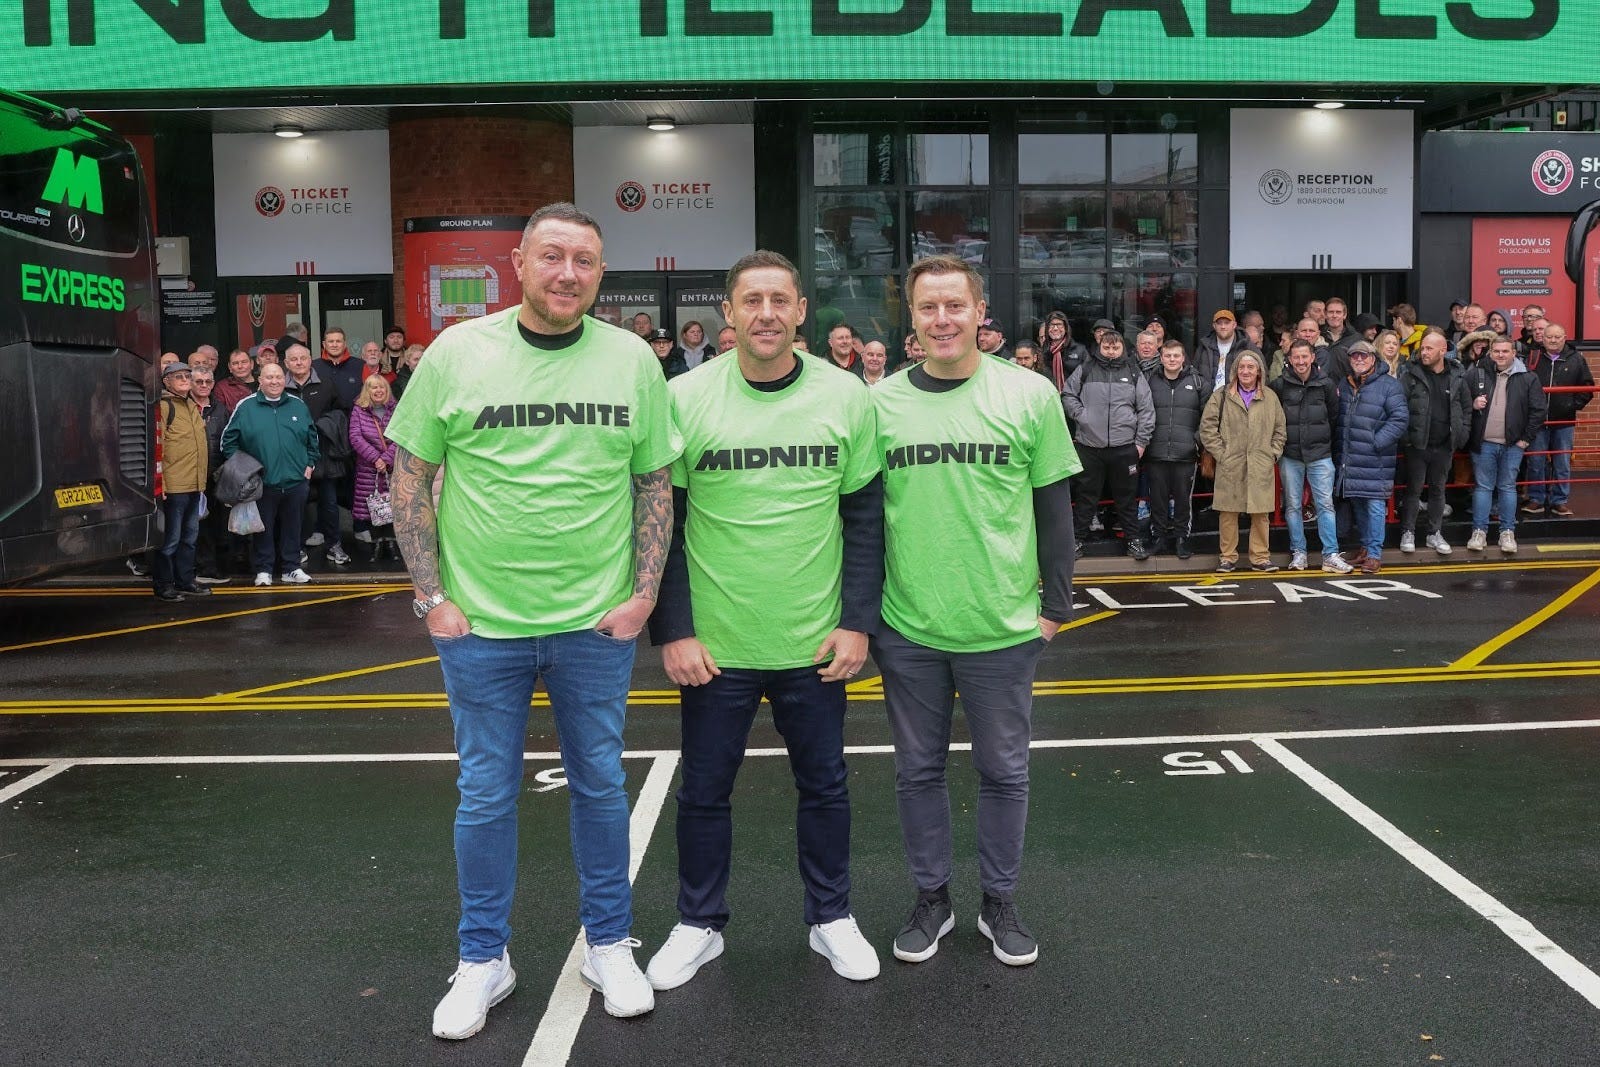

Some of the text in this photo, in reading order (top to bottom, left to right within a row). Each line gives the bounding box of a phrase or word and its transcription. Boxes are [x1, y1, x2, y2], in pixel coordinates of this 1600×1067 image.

[1298, 174, 1373, 185] RECEPTION
[291, 188, 349, 199] TICKET
[653, 183, 711, 194] TICKET
[1358, 187, 1389, 195] LOUNGE
[653, 197, 714, 209] OFFICE
[1297, 197, 1345, 205] BOARDROOM
[291, 202, 352, 214] OFFICE
[440, 218, 493, 228] GROUND PLAN
[1499, 238, 1551, 247] FOLLOW US
[21, 263, 125, 312] EXPRESS
[343, 298, 364, 306] EXIT
[600, 294, 655, 302] ENTRANCE
[473, 402, 630, 430] MIDNITE
[695, 445, 839, 471] MIDNITE
[886, 442, 1010, 470] MIDNITE
[1038, 578, 1442, 610] LEAR
[1162, 749, 1255, 776] 15
